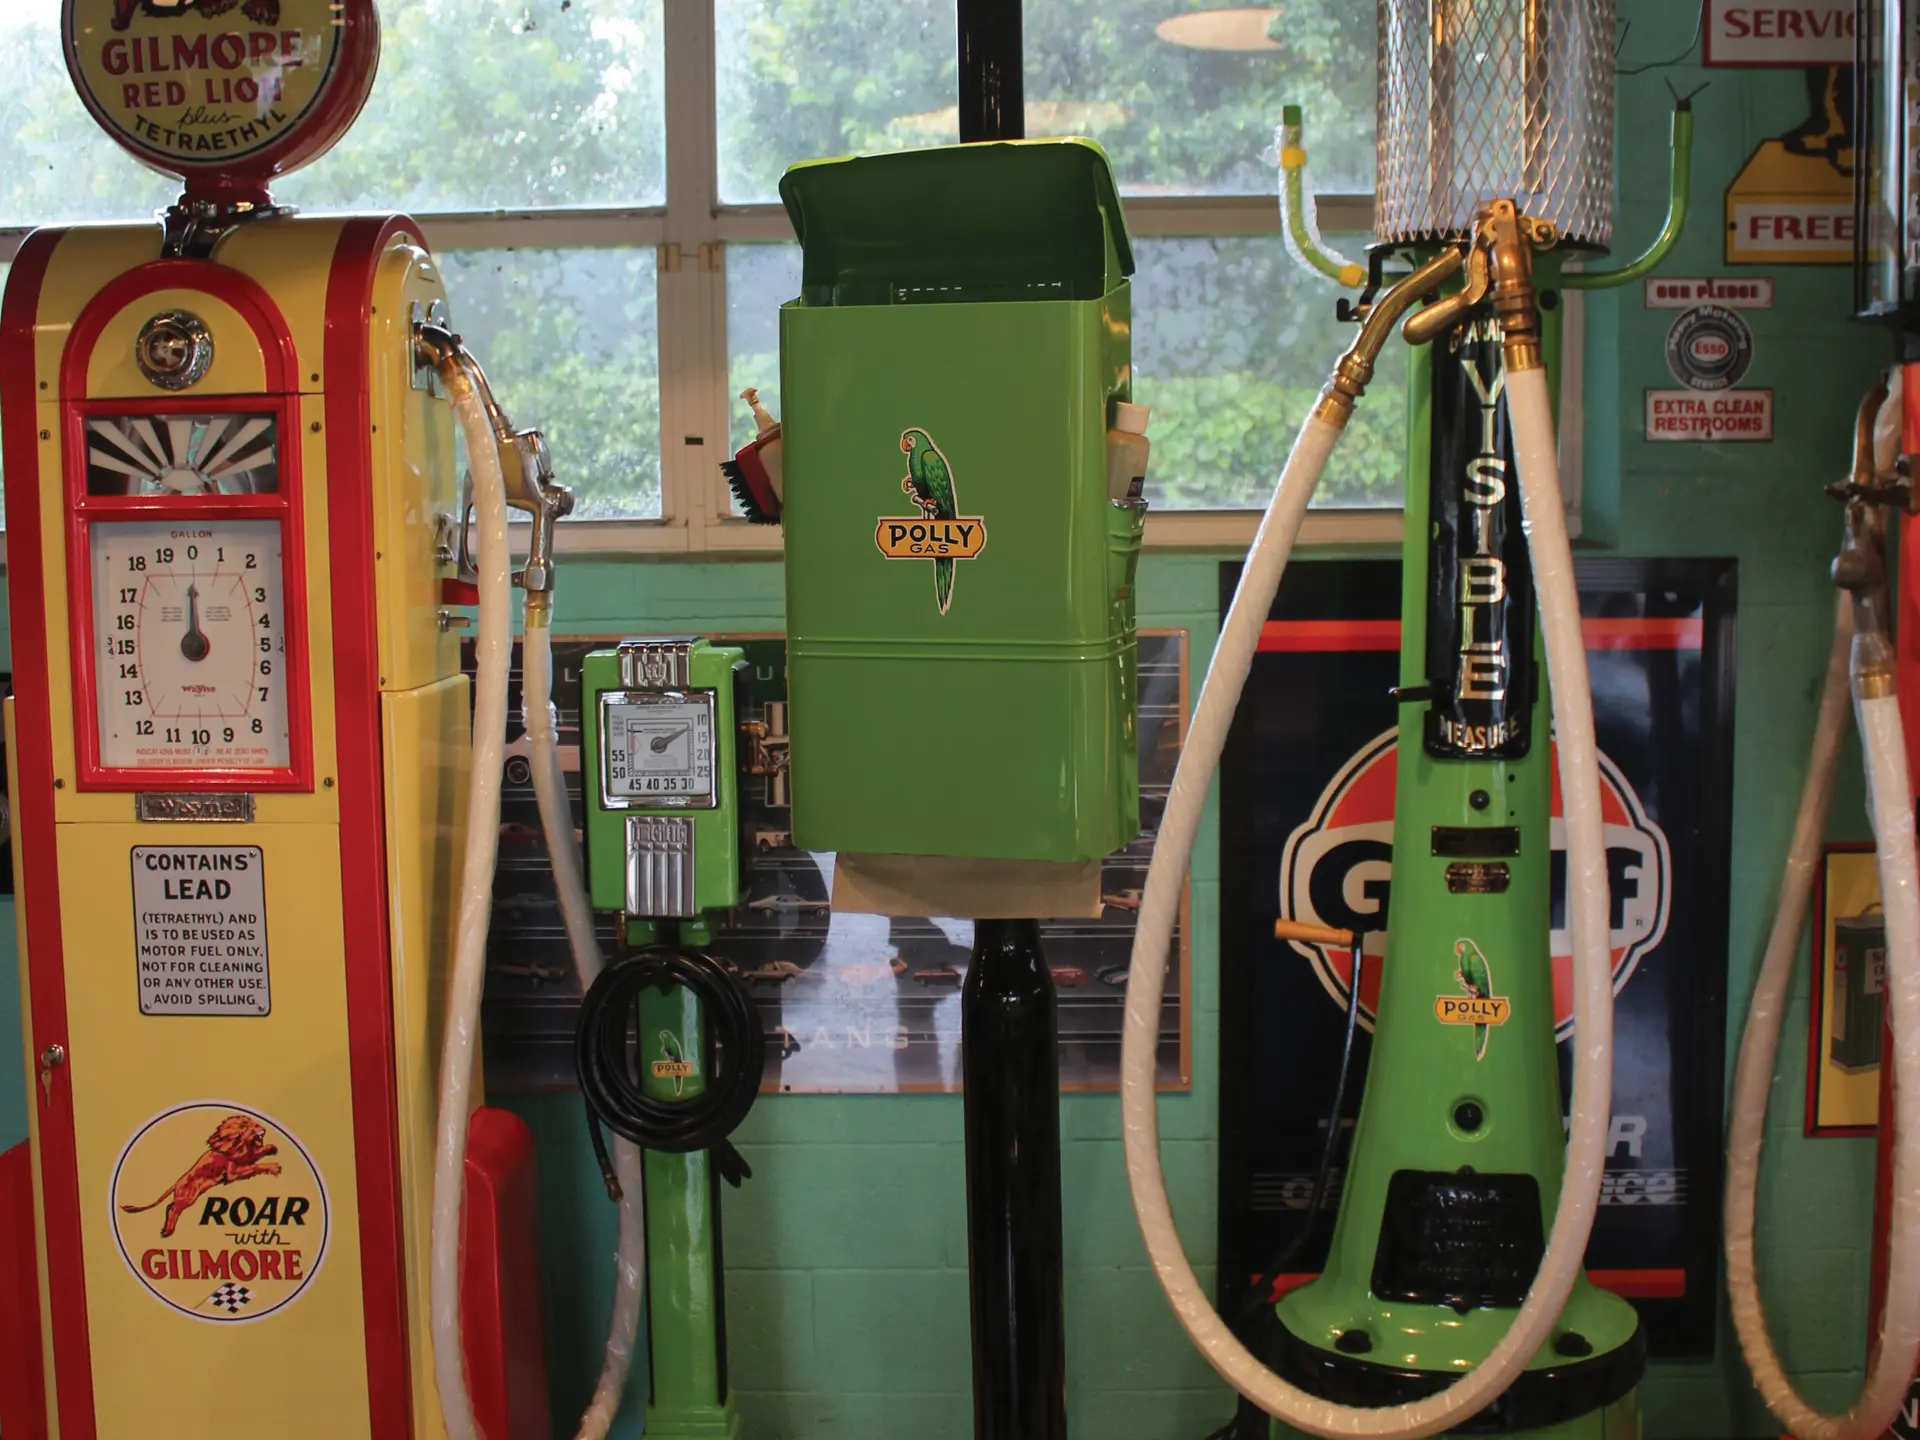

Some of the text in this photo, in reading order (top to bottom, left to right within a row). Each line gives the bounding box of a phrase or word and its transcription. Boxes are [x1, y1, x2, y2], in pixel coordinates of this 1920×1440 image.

[102, 31, 304, 75] GILMORE
[122, 80, 186, 109] RED
[176, 106, 242, 128] plus
[134, 109, 288, 152] TETRAETHYL
[1750, 215, 1855, 241] FREE
[1694, 341, 1726, 355] Esso
[1654, 400, 1765, 414] EXTRA CLEAN
[1655, 416, 1762, 432] RESTROOMS
[170, 530, 213, 539] GALLON
[888, 524, 975, 548] POLLY
[1459, 359, 1508, 701] VISIBLE
[155, 545, 225, 564] 19 0 1
[910, 543, 949, 554] GAS
[128, 556, 147, 571] 18
[245, 554, 257, 569] 2
[120, 588, 137, 603] 17
[255, 588, 266, 603] 3
[117, 615, 135, 630] 16
[258, 613, 270, 628] 4
[117, 640, 135, 655] 15
[260, 637, 271, 652] 5
[120, 664, 138, 679] 14
[260, 660, 271, 675] 6
[125, 691, 143, 706] 13
[258, 687, 269, 702] 7
[252, 719, 263, 734] 8
[697, 714, 707, 726] 10
[136, 721, 154, 736] 12
[166, 728, 181, 743] 11
[223, 728, 234, 742] 9
[1439, 714, 1521, 752] MEASURE
[192, 730, 210, 745] 10
[698, 732, 708, 744] 15
[612, 750, 625, 762] 55
[612, 767, 626, 779] 50
[697, 766, 710, 778] 25
[629, 778, 694, 790] 45 40 35 30
[145, 853, 248, 871] CONTAINS
[164, 878, 231, 900] LEAD
[142, 911, 257, 925] (TETRAETHYL) AND
[145, 929, 256, 941] IS TO BE USED AS
[141, 945, 264, 957] MOTOR FUEL ONLY.
[142, 961, 264, 973] NOT FOR CLEANING
[143, 978, 267, 990] OR ANY OTHER USE.
[153, 994, 256, 1006] AVOID SPILLING
[1444, 1001, 1503, 1017] POLLY
[1458, 1014, 1485, 1022] GAS
[775, 1026, 910, 1049] TANG
[657, 1064, 688, 1072] POLLY
[199, 1196, 310, 1227] ROAR
[225, 1229, 291, 1245] with
[141, 1248, 304, 1282] GILMORE
